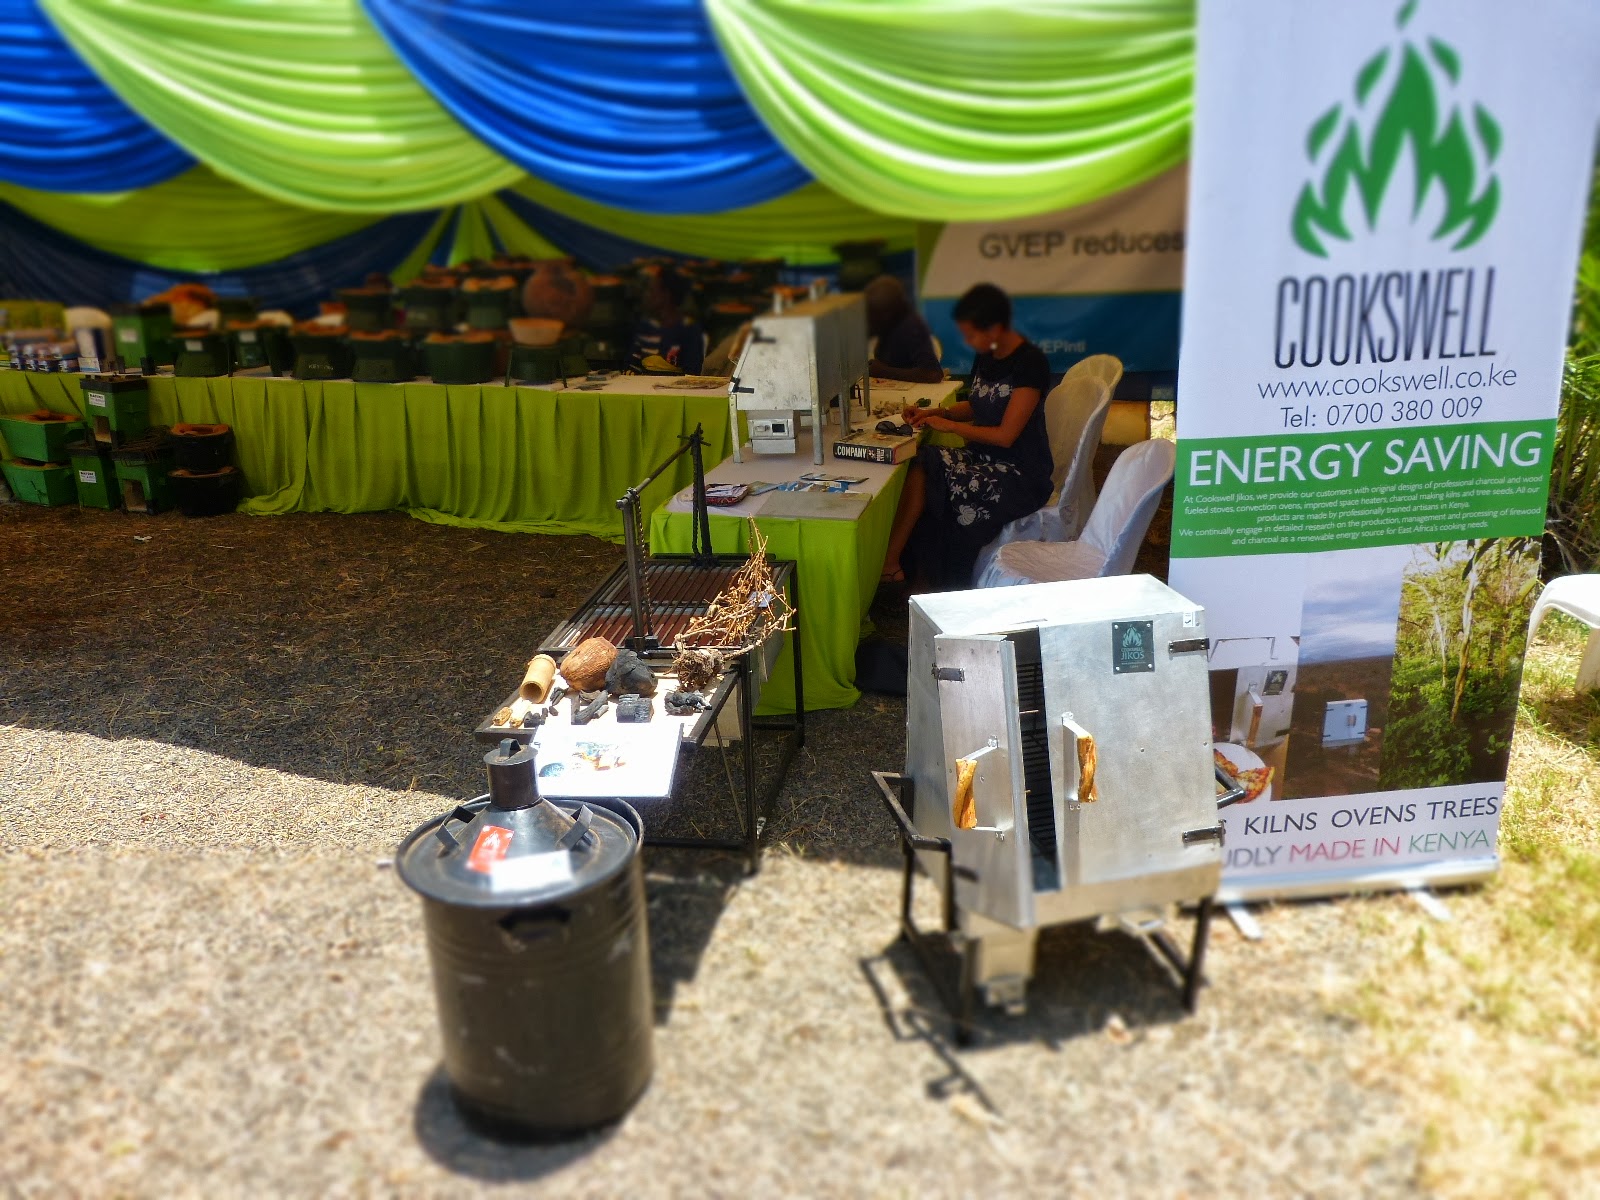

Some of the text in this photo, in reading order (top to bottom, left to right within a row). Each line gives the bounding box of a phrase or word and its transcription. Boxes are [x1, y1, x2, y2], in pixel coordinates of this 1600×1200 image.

[979, 229, 1185, 259] GVEP reduces
[1274, 267, 1497, 369] COOKSWELL
[1257, 363, 1517, 398] www.cookswell.co.ke
[1280, 397, 1483, 428] Tel: 0700 380 009
[837, 446, 867, 458] COMPANY
[1189, 431, 1543, 486] ENERGY SAVING
[1185, 506, 1208, 515] fueled
[1236, 504, 1277, 512] convection
[1304, 500, 1338, 509] improved
[1340, 498, 1359, 508] space
[1390, 494, 1418, 502] charcoal
[1420, 492, 1444, 500] making
[1446, 490, 1460, 498] kilns
[1195, 494, 1235, 503] Cookswell
[1270, 491, 1298, 500] provide
[1316, 488, 1352, 497] customers
[1371, 484, 1396, 494] original
[1398, 483, 1422, 492] designs
[1434, 477, 1473, 489] professional
[1475, 477, 1505, 485] charcoal
[1195, 526, 1234, 536] continually
[1236, 526, 1262, 535] engage
[1273, 524, 1303, 532] detailed
[1305, 522, 1335, 531] research
[1402, 514, 1446, 524] management
[1462, 510, 1498, 520] processing
[1510, 507, 1541, 515] firewood
[1256, 514, 1290, 523] products
[1306, 511, 1327, 520] made
[1329, 511, 1337, 519] by
[1339, 507, 1385, 518] professionally
[1386, 505, 1410, 514] trained
[1412, 503, 1439, 511] artisans
[1232, 537, 1246, 545] and
[1248, 535, 1278, 544] charcoal
[1297, 533, 1334, 542] renewable
[1336, 531, 1360, 540] energy
[1361, 529, 1384, 537] source
[1397, 526, 1413, 534] East
[1440, 522, 1466, 531] cooking
[1121, 651, 1144, 660] JIKOS
[1244, 812, 1318, 835] KILNS
[1331, 804, 1417, 828] OVENS
[1427, 797, 1499, 820] TREES
[1223, 829, 1489, 869] UDLY MADE IN KENYA
